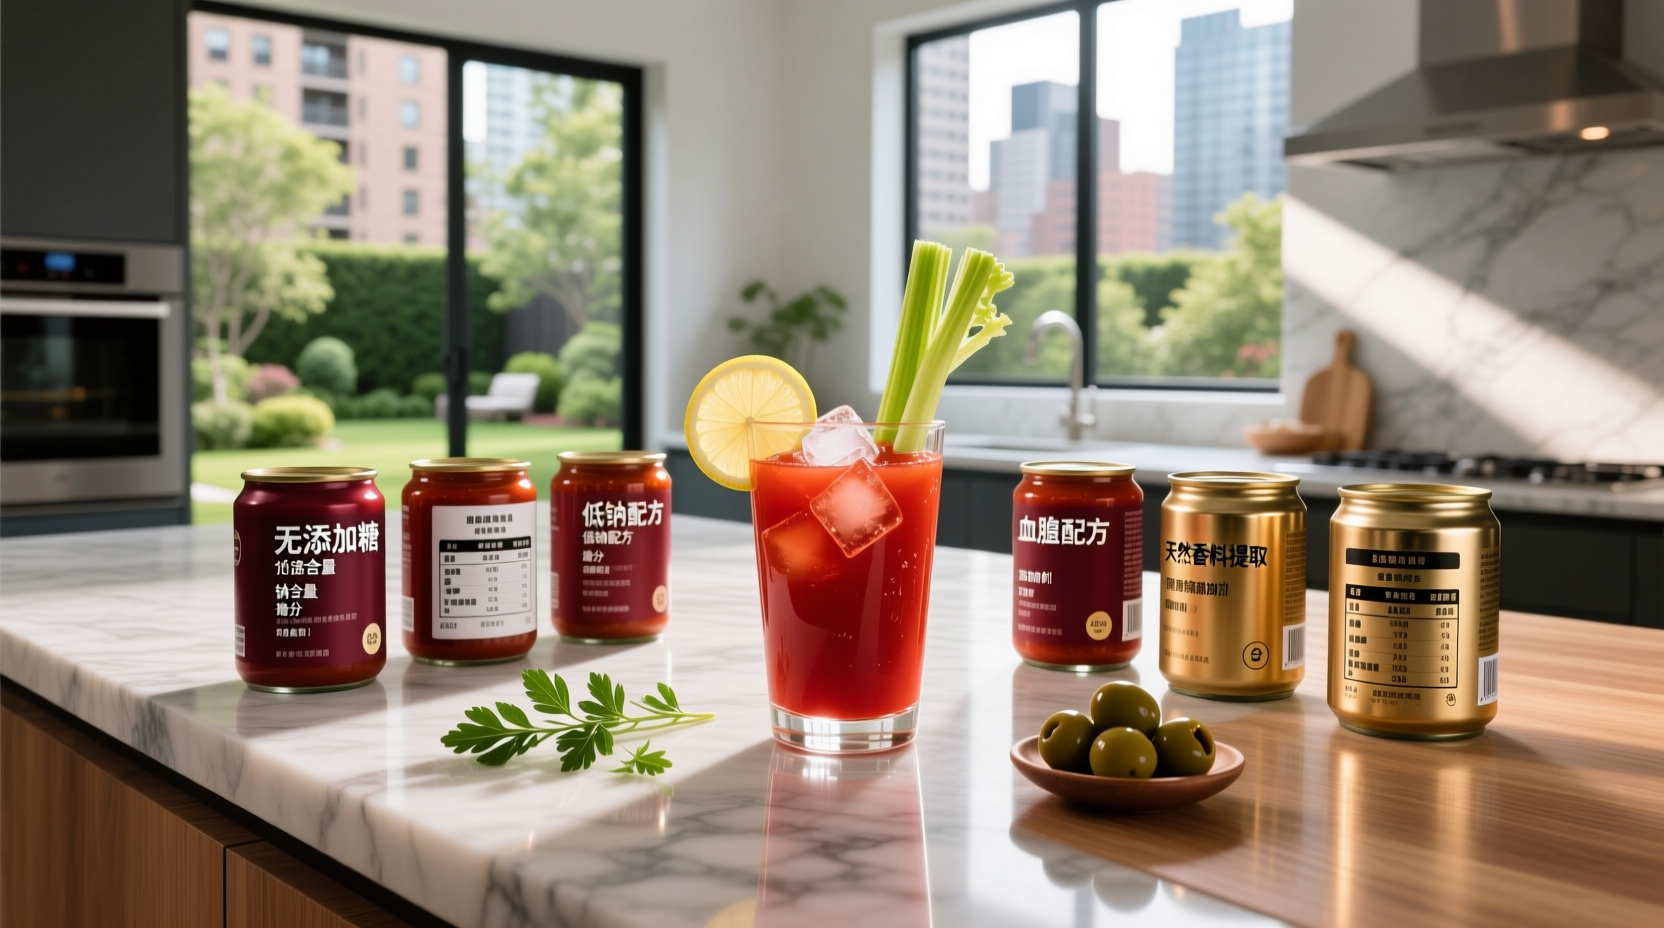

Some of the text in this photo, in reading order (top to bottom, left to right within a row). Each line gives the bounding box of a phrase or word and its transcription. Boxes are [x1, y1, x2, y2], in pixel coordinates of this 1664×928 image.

[582, 499, 664, 528] 低钠配方
[274, 520, 380, 555] 无添加糖
[1165, 540, 1268, 568] 天然香料提取
